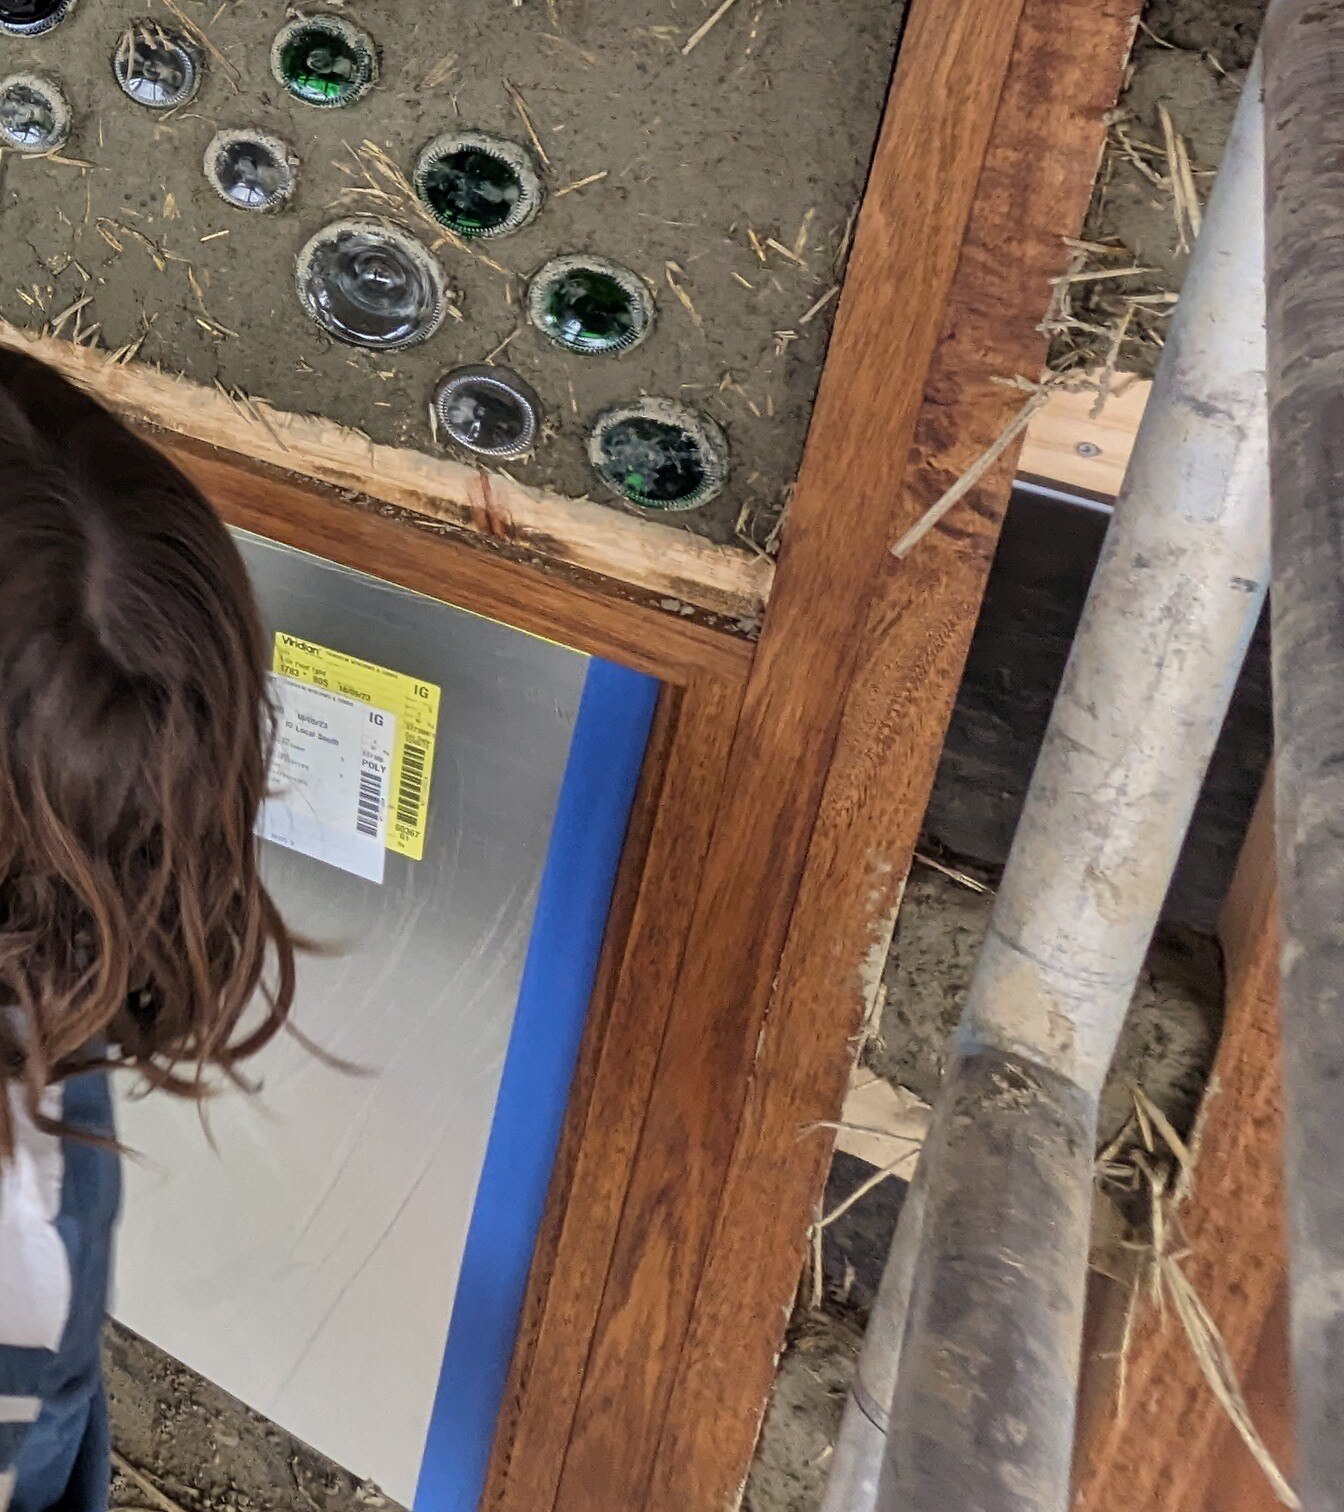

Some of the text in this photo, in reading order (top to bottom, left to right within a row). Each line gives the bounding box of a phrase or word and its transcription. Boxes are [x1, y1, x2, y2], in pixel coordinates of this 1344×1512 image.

[281, 634, 320, 656] Viridian
[414, 684, 430, 699] IG
[369, 711, 385, 727] IG
[361, 759, 387, 774] POLY
